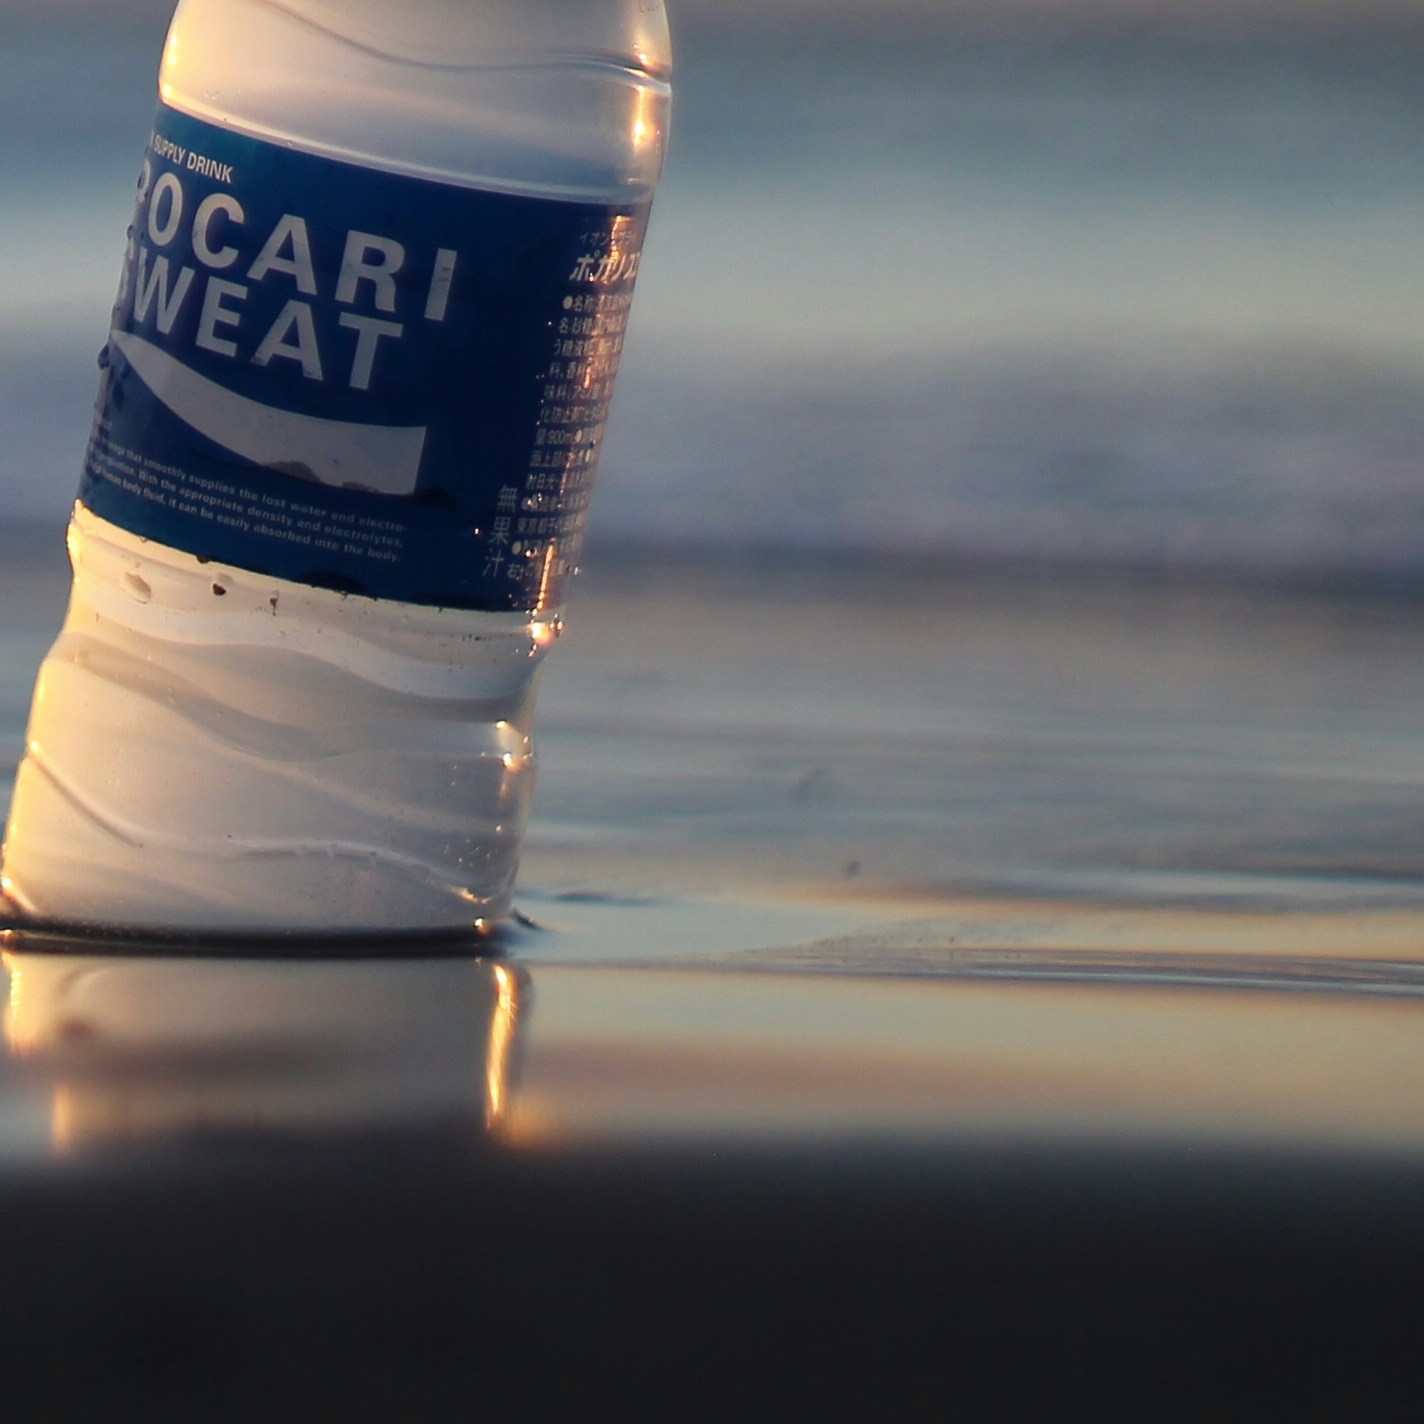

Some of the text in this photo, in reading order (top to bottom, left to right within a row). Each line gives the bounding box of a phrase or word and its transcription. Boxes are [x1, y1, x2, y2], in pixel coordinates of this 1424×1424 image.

[153, 134, 186, 165] SUPPLY
[187, 151, 234, 184] DRINK
[144, 459, 186, 481] smoothly
[189, 474, 235, 495] supplies
[239, 488, 258, 502] the
[262, 493, 286, 508] lost
[290, 502, 327, 519] water
[331, 510, 356, 525] and
[160, 477, 177, 492] the
[179, 487, 244, 514] appropriate
[247, 505, 293, 527] density
[297, 519, 322, 533] and
[324, 524, 404, 548] electrolytes,
[179, 502, 198, 516] can
[200, 507, 214, 521] be
[216, 513, 251, 532] easily
[253, 524, 312, 545] absorbed
[315, 537, 340, 552] into
[343, 542, 365, 557] the
[482, 483, 518, 579] 無果汁
